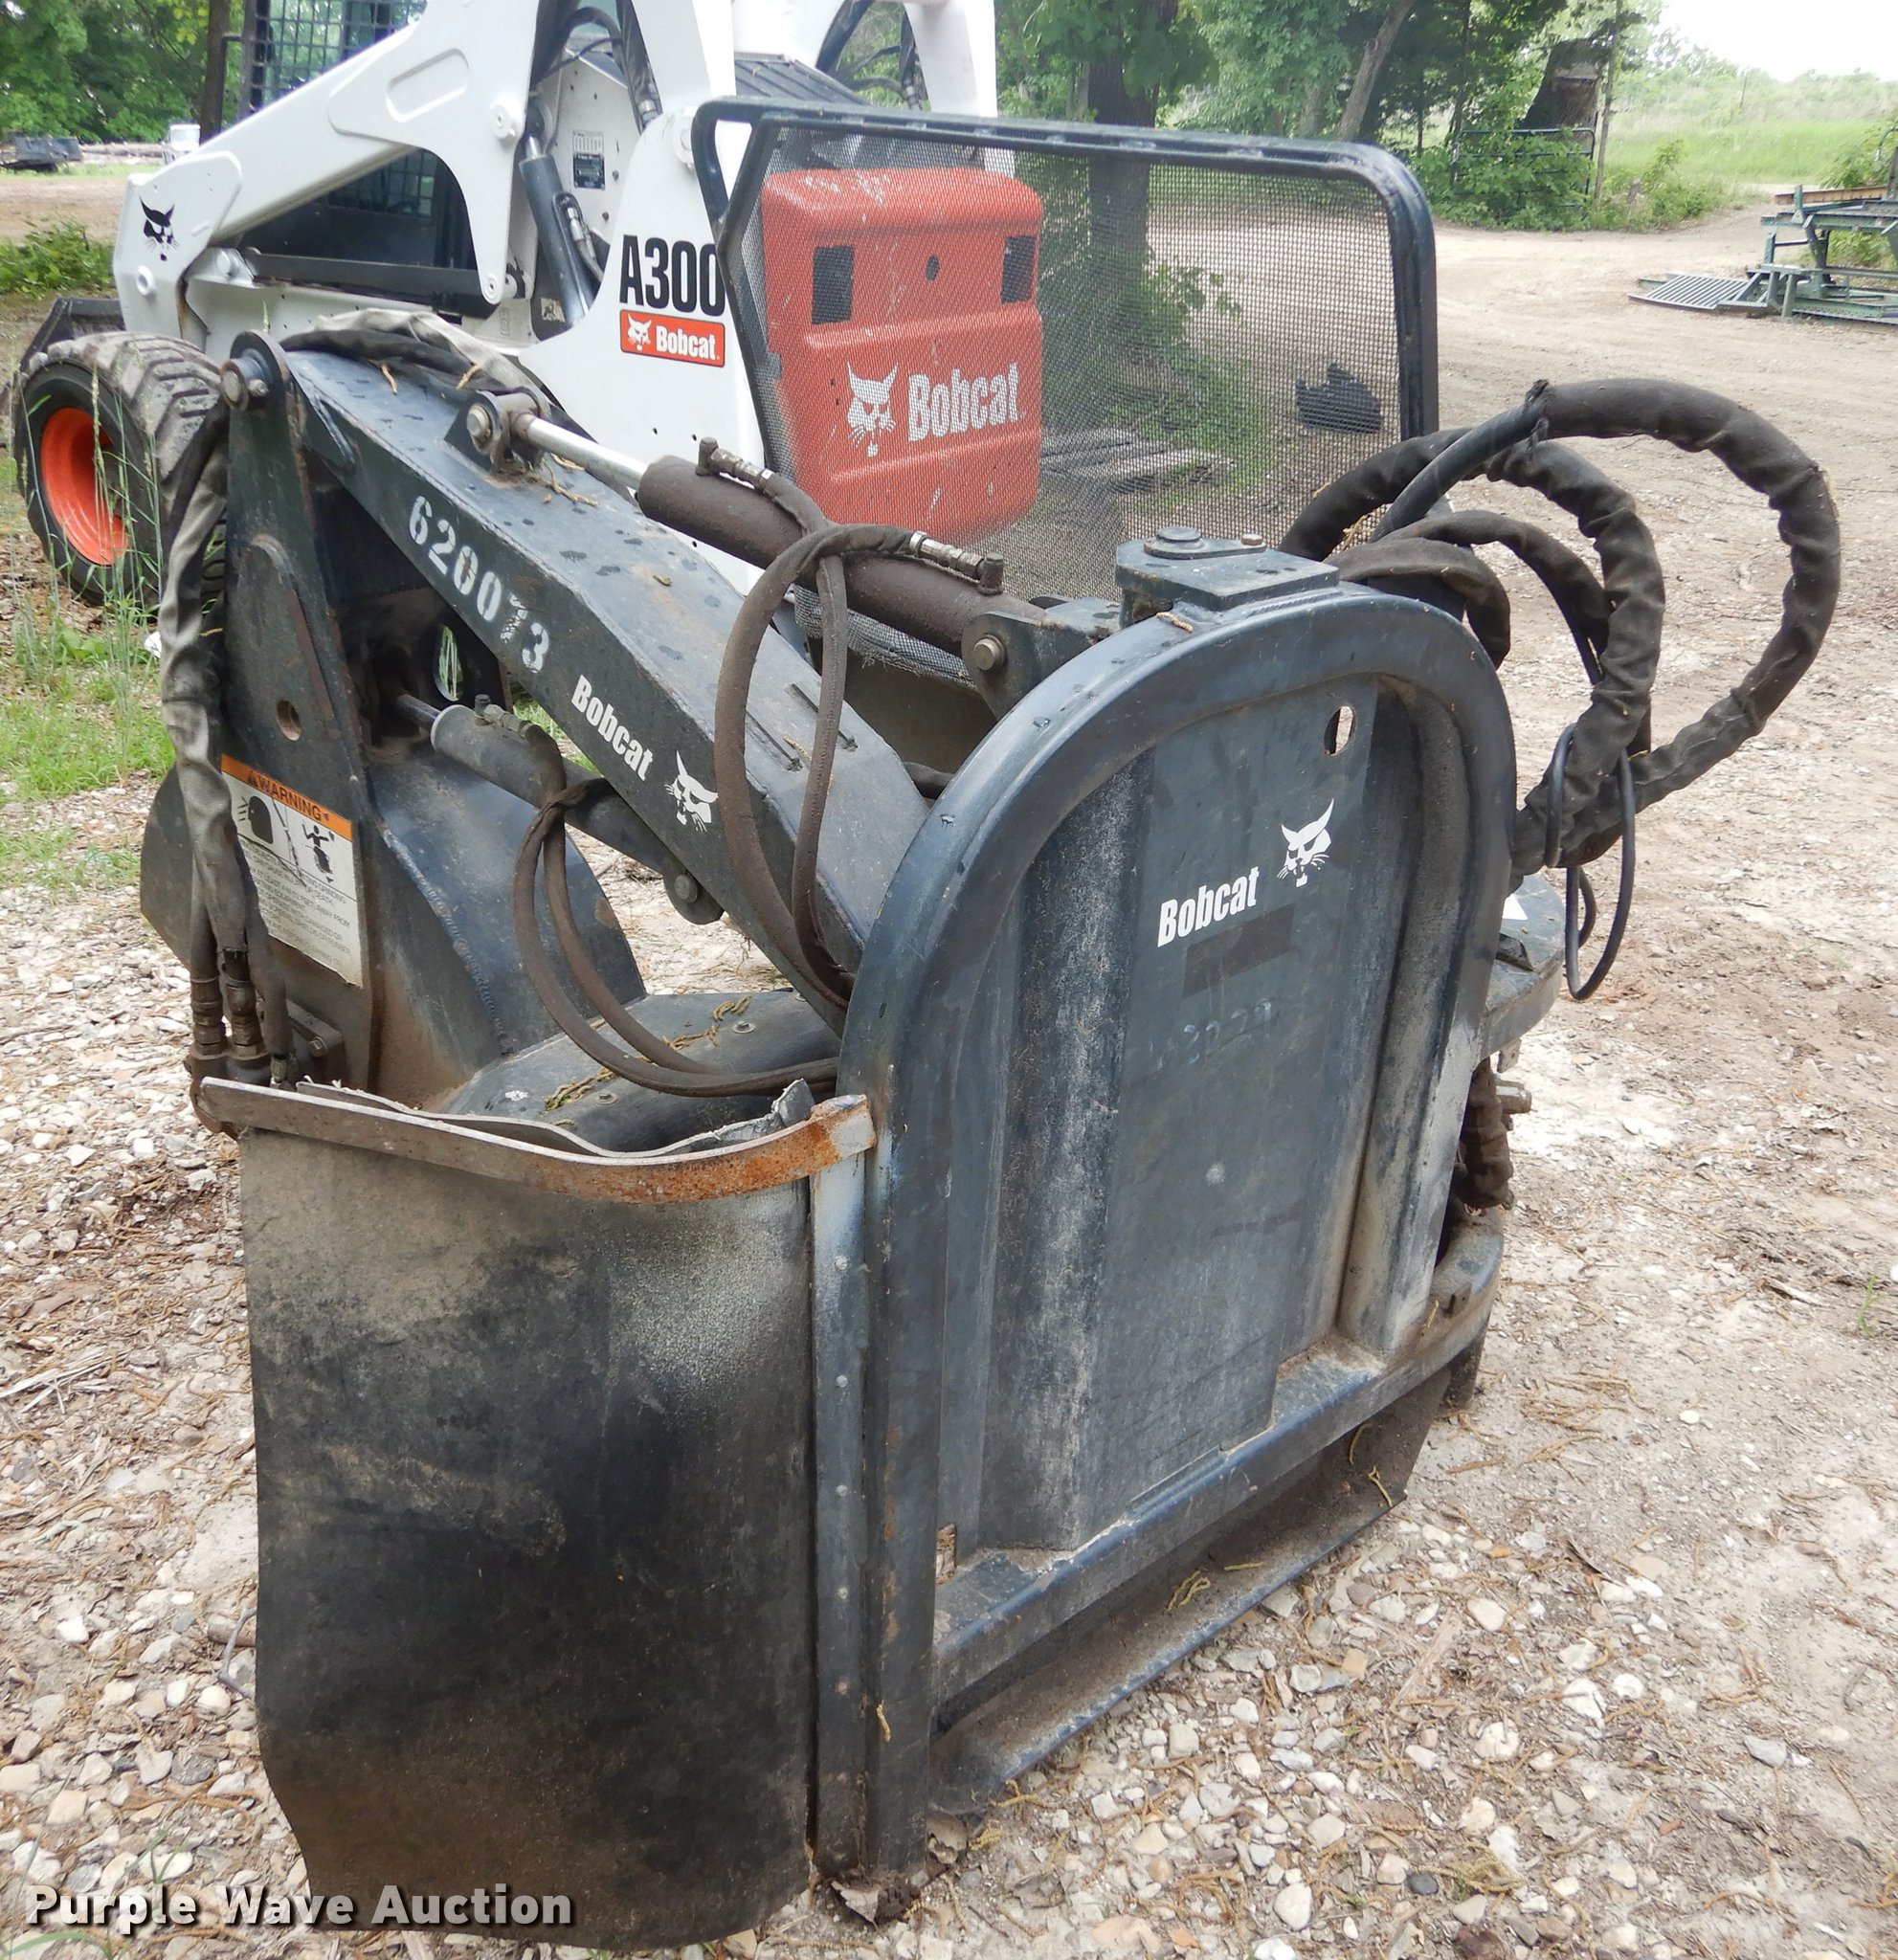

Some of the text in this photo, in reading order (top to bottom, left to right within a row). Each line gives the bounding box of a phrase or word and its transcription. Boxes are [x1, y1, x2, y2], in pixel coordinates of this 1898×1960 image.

[619, 234, 726, 316] A300
[655, 324, 720, 360] Bobcat
[907, 362, 1026, 442] Bobcat
[570, 675, 654, 782] Bobcat
[257, 774, 322, 821] WARNING
[1157, 866, 1260, 948] Bobcat
